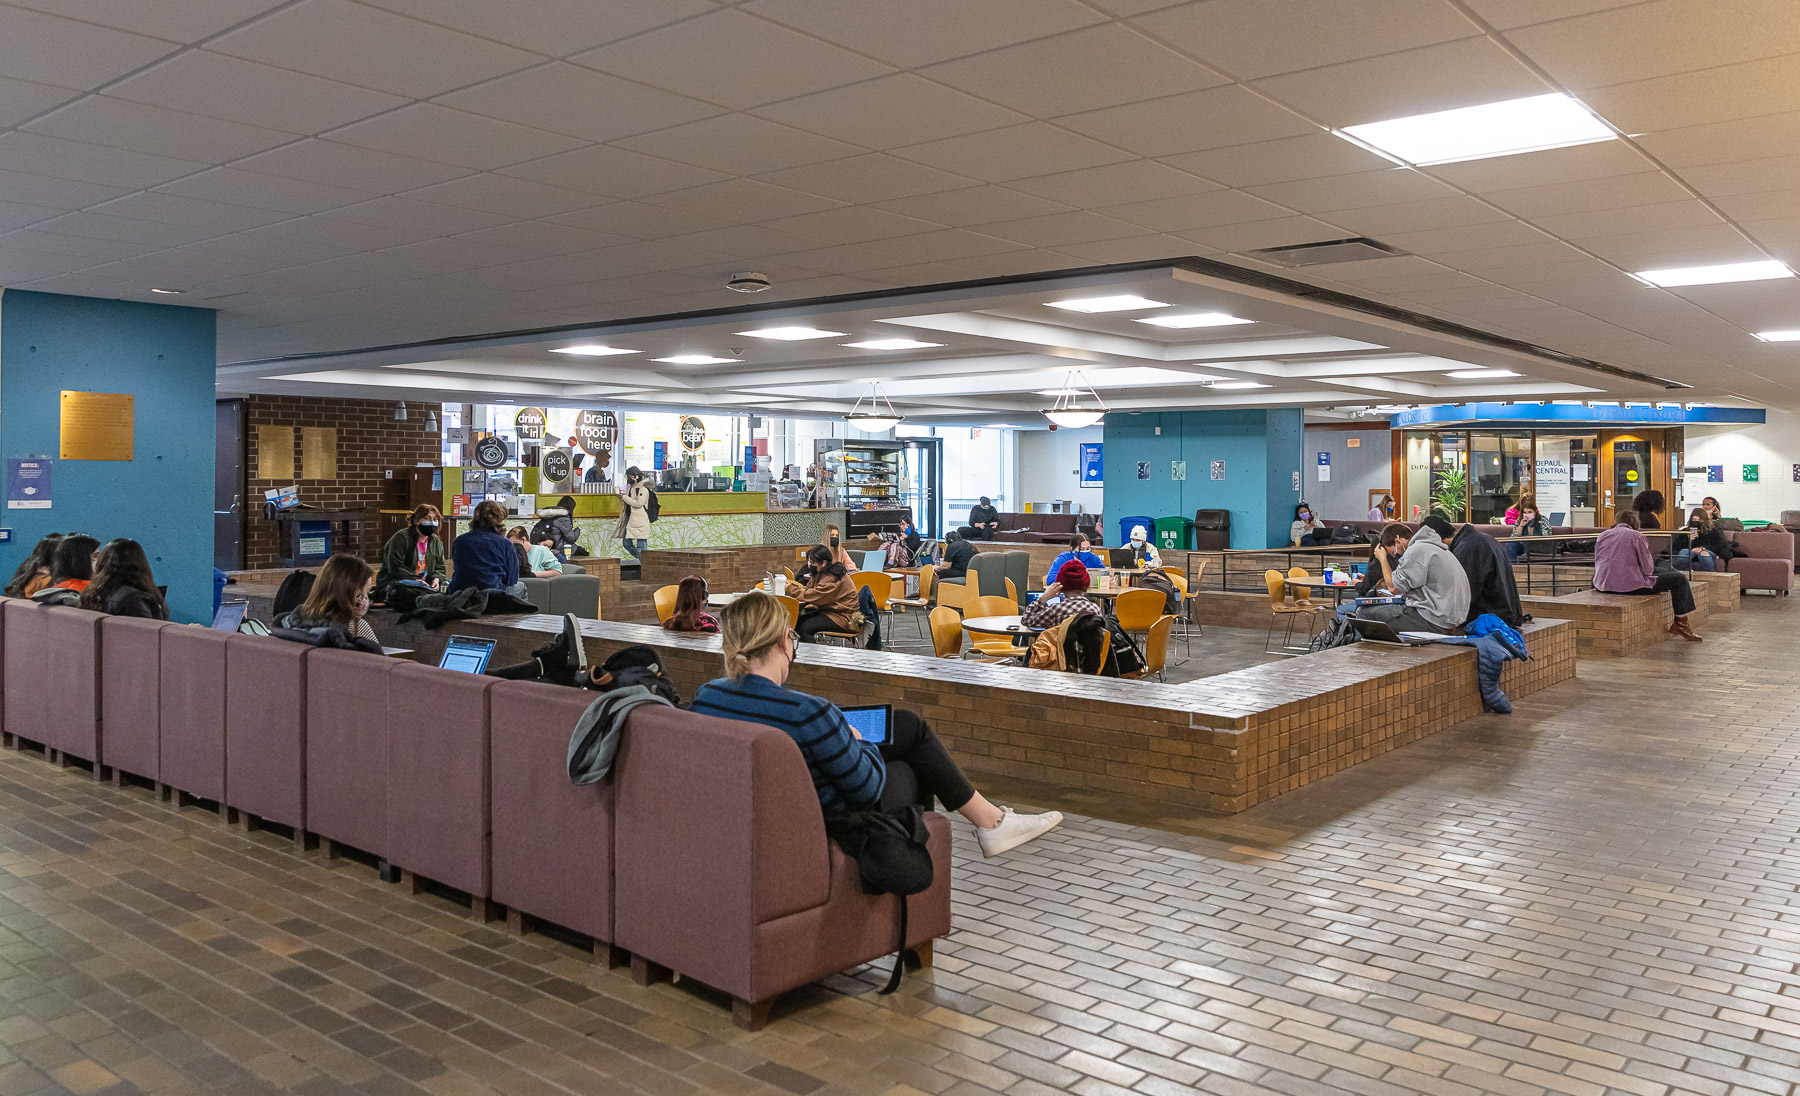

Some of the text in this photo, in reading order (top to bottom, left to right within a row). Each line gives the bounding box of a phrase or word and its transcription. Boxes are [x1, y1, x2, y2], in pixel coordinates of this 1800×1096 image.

[518, 413, 543, 424] drink
[583, 411, 614, 425] brain
[580, 424, 608, 438] food
[683, 432, 704, 442] bean
[587, 438, 611, 450] here
[547, 456, 566, 467] pick
[550, 466, 556, 474] it
[557, 469, 567, 477] up
